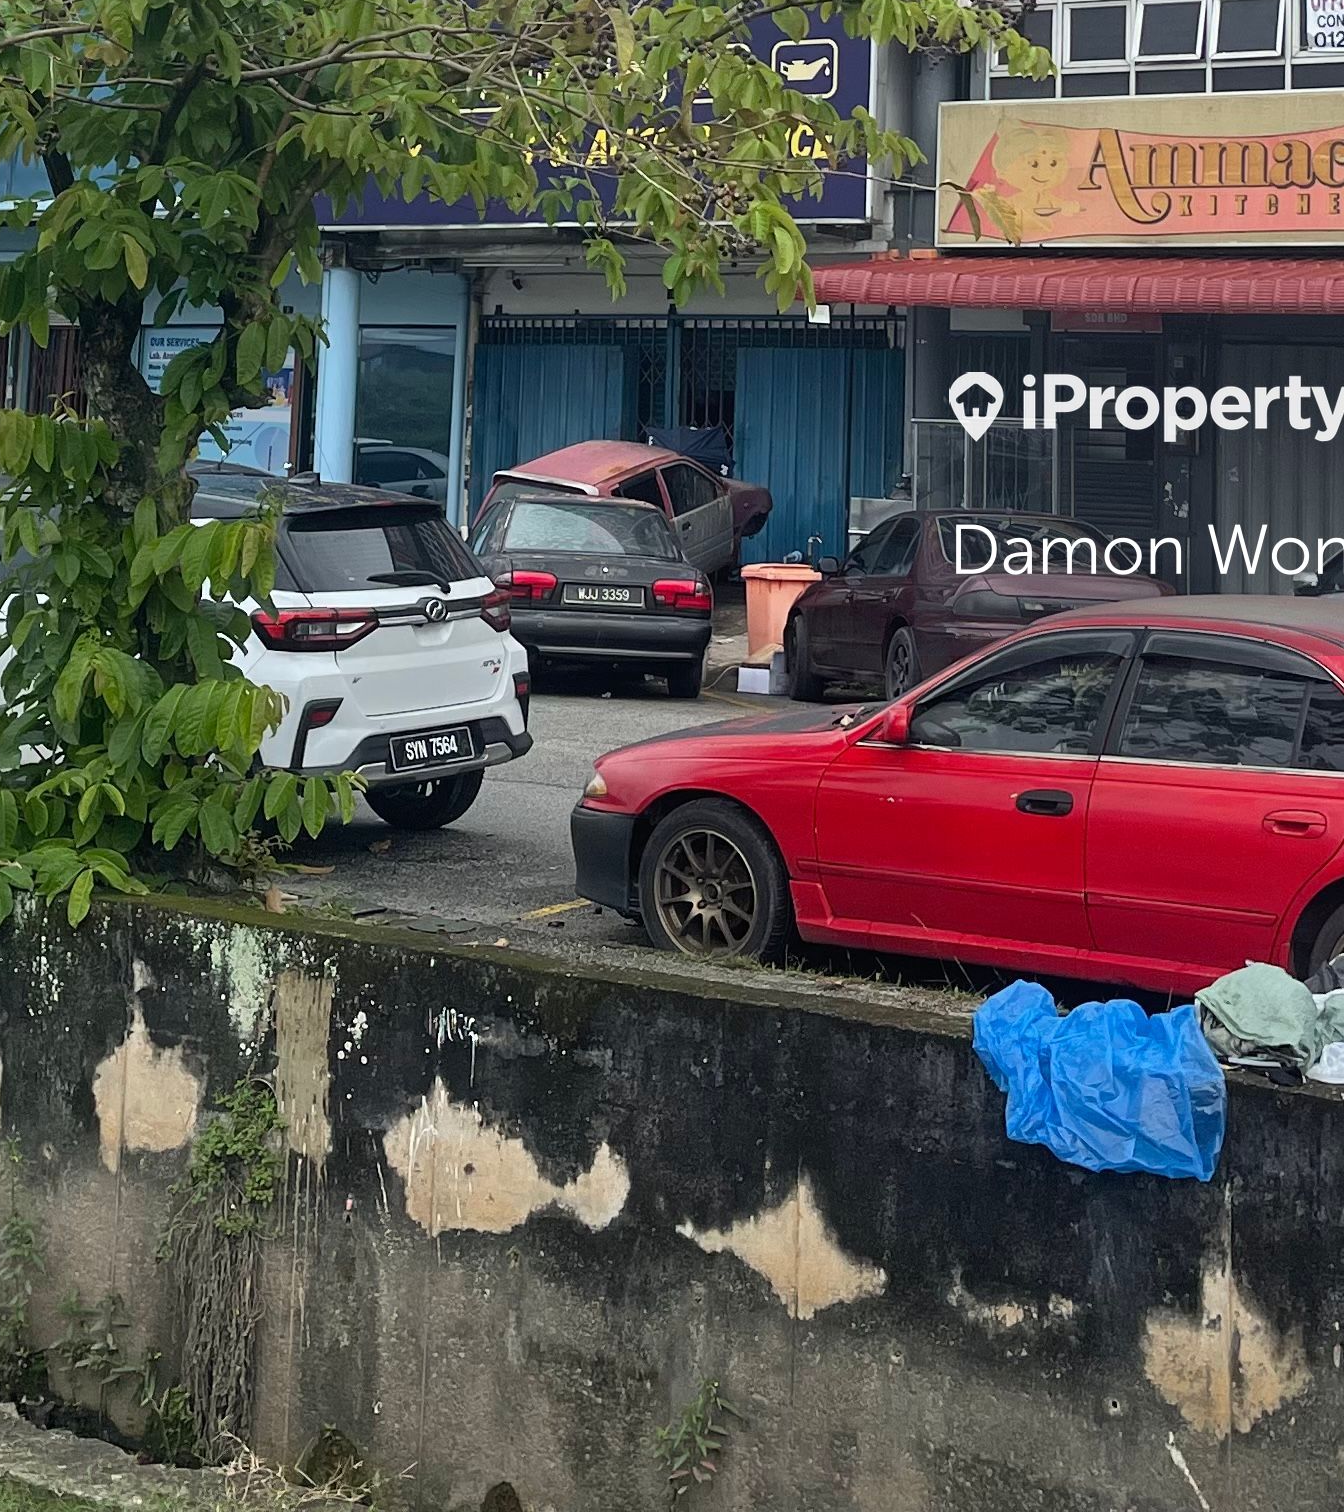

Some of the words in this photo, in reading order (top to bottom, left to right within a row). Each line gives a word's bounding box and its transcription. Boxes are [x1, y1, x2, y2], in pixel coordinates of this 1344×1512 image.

[578, 587, 599, 600] WJJ
[602, 588, 630, 601] 3359
[405, 739, 428, 760] SYN
[429, 735, 458, 757] 7564
